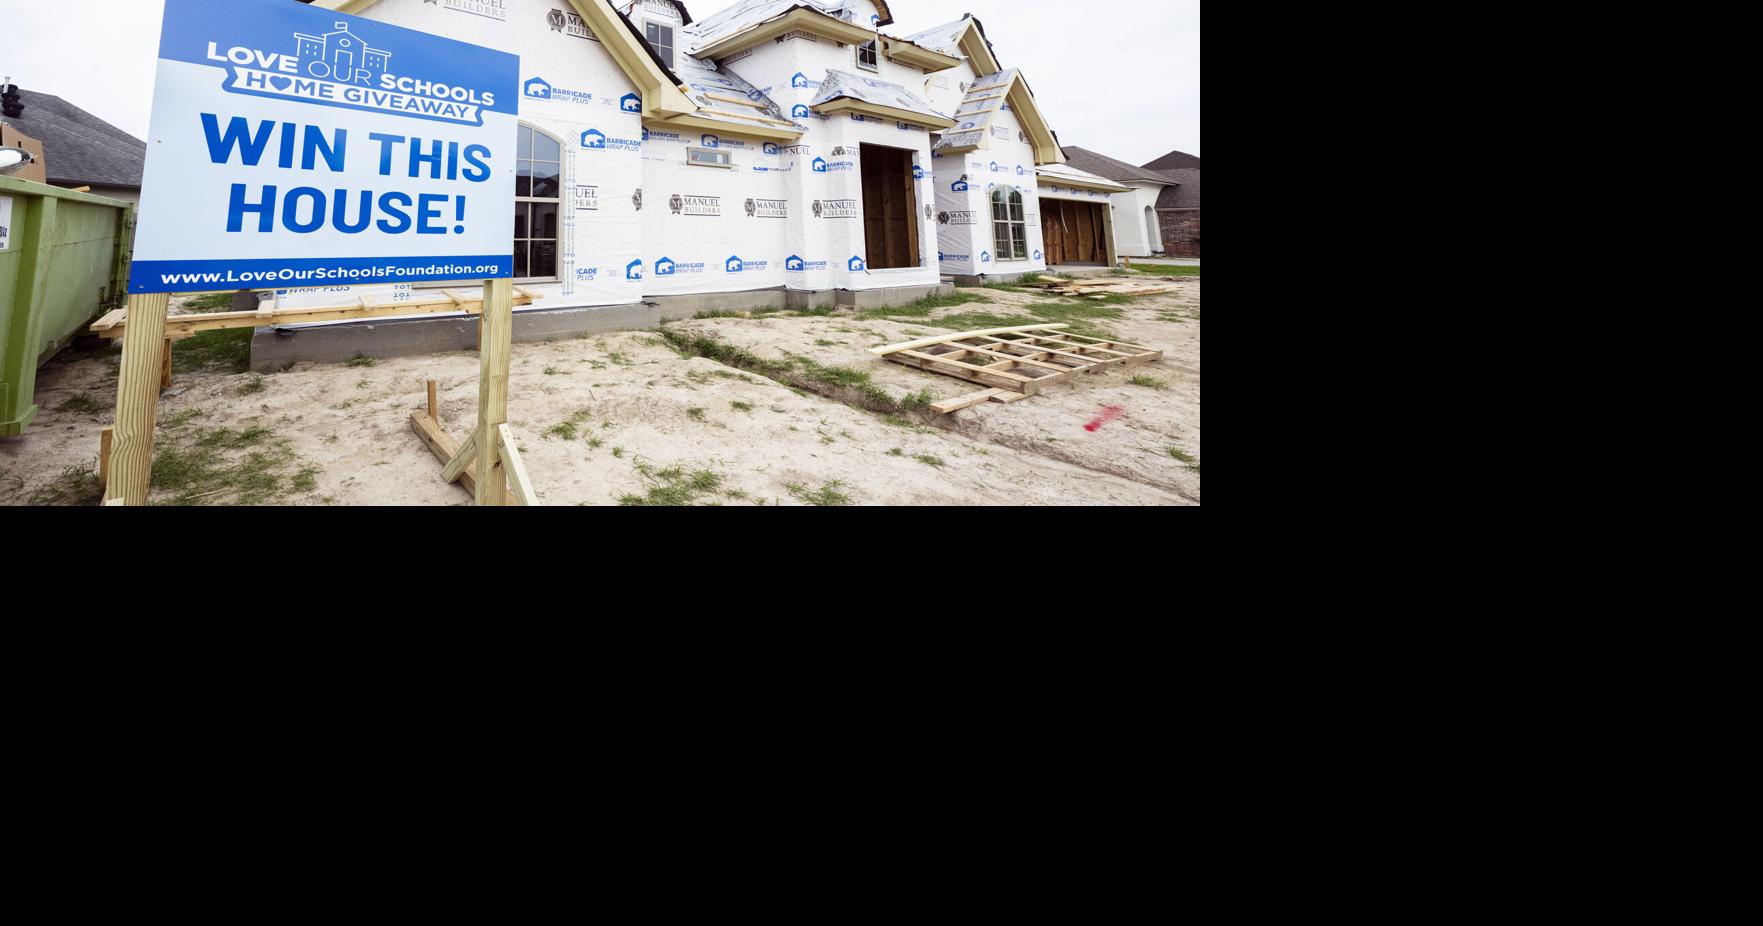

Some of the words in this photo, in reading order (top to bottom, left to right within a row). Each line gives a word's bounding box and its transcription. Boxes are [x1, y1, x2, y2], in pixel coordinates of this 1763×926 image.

[206, 41, 299, 73] LOVE
[308, 60, 371, 86] OUR
[380, 73, 495, 106] SCHOOLS
[343, 87, 469, 118] GIVEAWAY
[552, 87, 592, 100] BARRICADE
[200, 112, 348, 172] WIN
[368, 132, 492, 183] THIS
[226, 183, 466, 235] HOUSE!
[684, 198, 720, 207] MANUEL
[757, 201, 787, 210] MANUEL
[160, 262, 499, 285] www.LoveOurSchoolsFoundation.org
